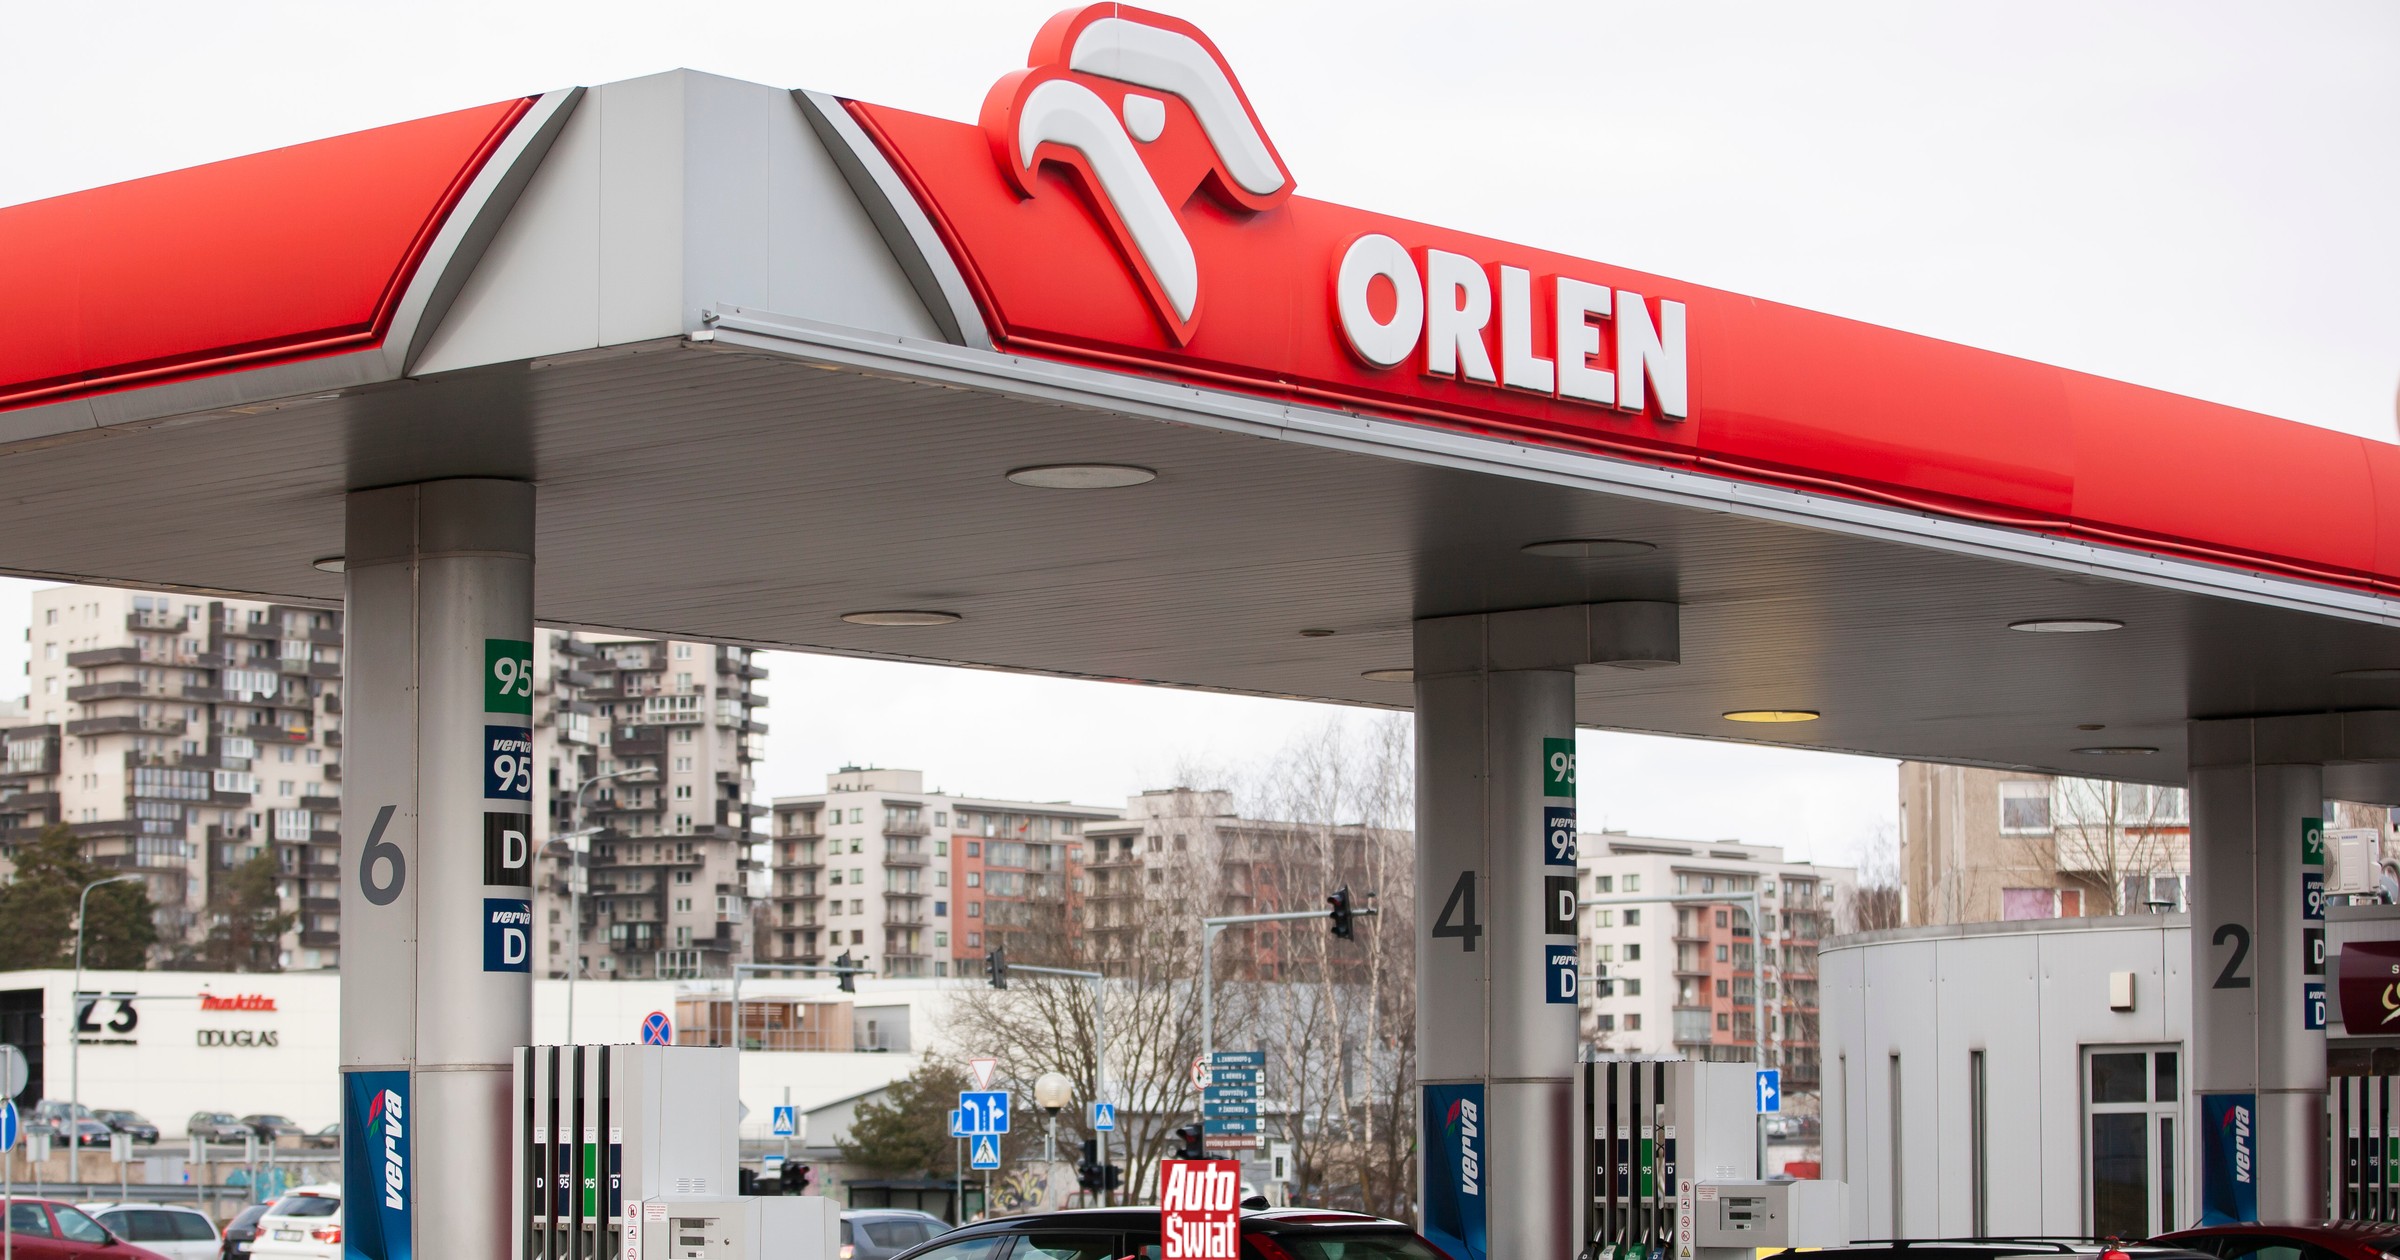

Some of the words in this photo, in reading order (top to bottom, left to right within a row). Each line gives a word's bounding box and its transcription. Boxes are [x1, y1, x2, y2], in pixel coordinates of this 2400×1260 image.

[1336, 232, 1688, 418] ORLEN
[494, 657, 532, 697] 95
[493, 739, 532, 754] verva
[493, 754, 531, 794] 95
[1550, 751, 1576, 785] 95
[360, 804, 406, 906] 6
[503, 829, 527, 869] D
[1551, 829, 1577, 861] 95
[492, 911, 531, 925] verva
[1432, 870, 1482, 952] 4
[1559, 889, 1576, 922] D
[504, 928, 527, 965] D
[2212, 923, 2251, 989] 2
[2314, 939, 2325, 965] D
[1561, 968, 1576, 998] D
[2315, 1002, 2326, 1026] D
[197, 1029, 278, 1047] DOUGLAS
[385, 1089, 404, 1211] verva
[1461, 1098, 1479, 1196] verva
[2235, 1105, 2250, 1184] verva
[536, 1177, 544, 1188] D
[559, 1178, 569, 1189] 95
[585, 1178, 595, 1189] 95
[612, 1178, 619, 1189] D
[1597, 1166, 1603, 1175] D
[1618, 1166, 1628, 1175] 95
[1642, 1166, 1652, 1175] 95
[1667, 1166, 1673, 1175] D
